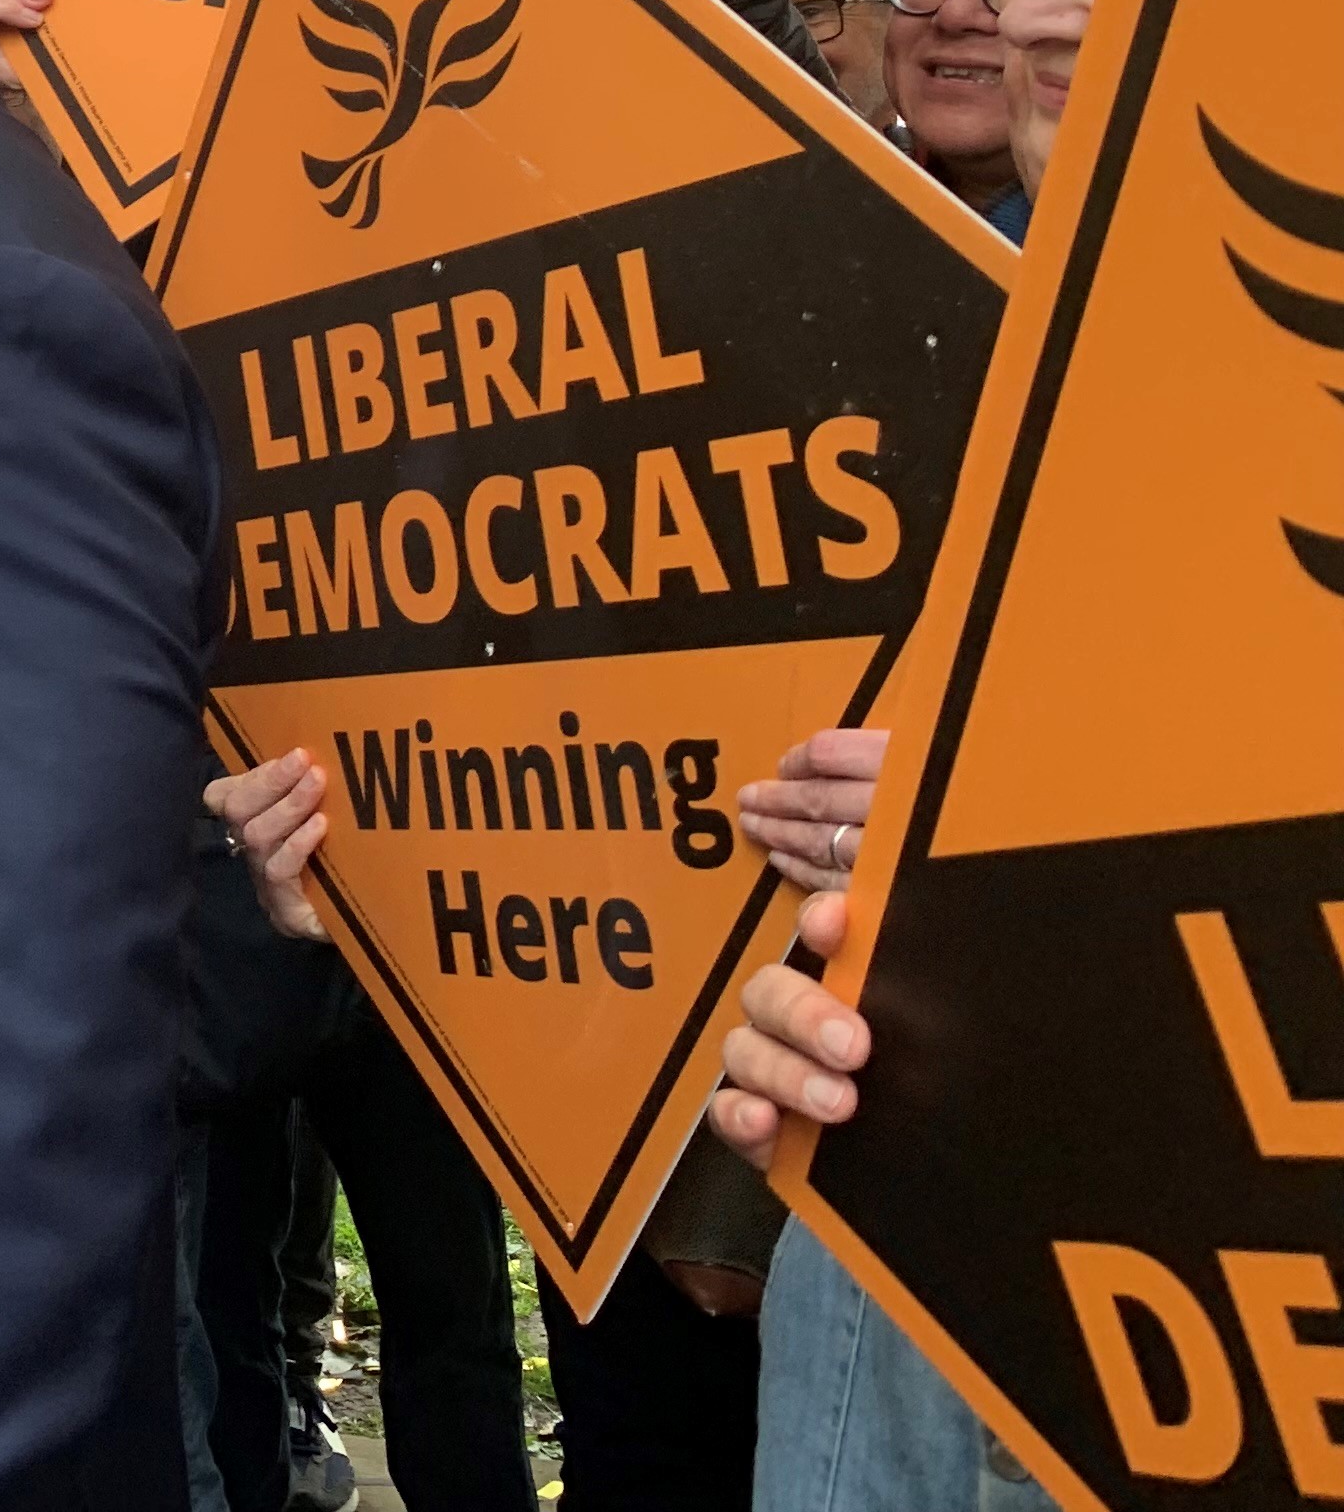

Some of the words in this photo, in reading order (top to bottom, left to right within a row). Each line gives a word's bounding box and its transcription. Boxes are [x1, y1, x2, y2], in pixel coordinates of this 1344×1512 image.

[240, 247, 706, 472] LIBERAL
[226, 415, 902, 641] EMOCRATS
[335, 710, 735, 870] Winning
[428, 868, 655, 991] Here
